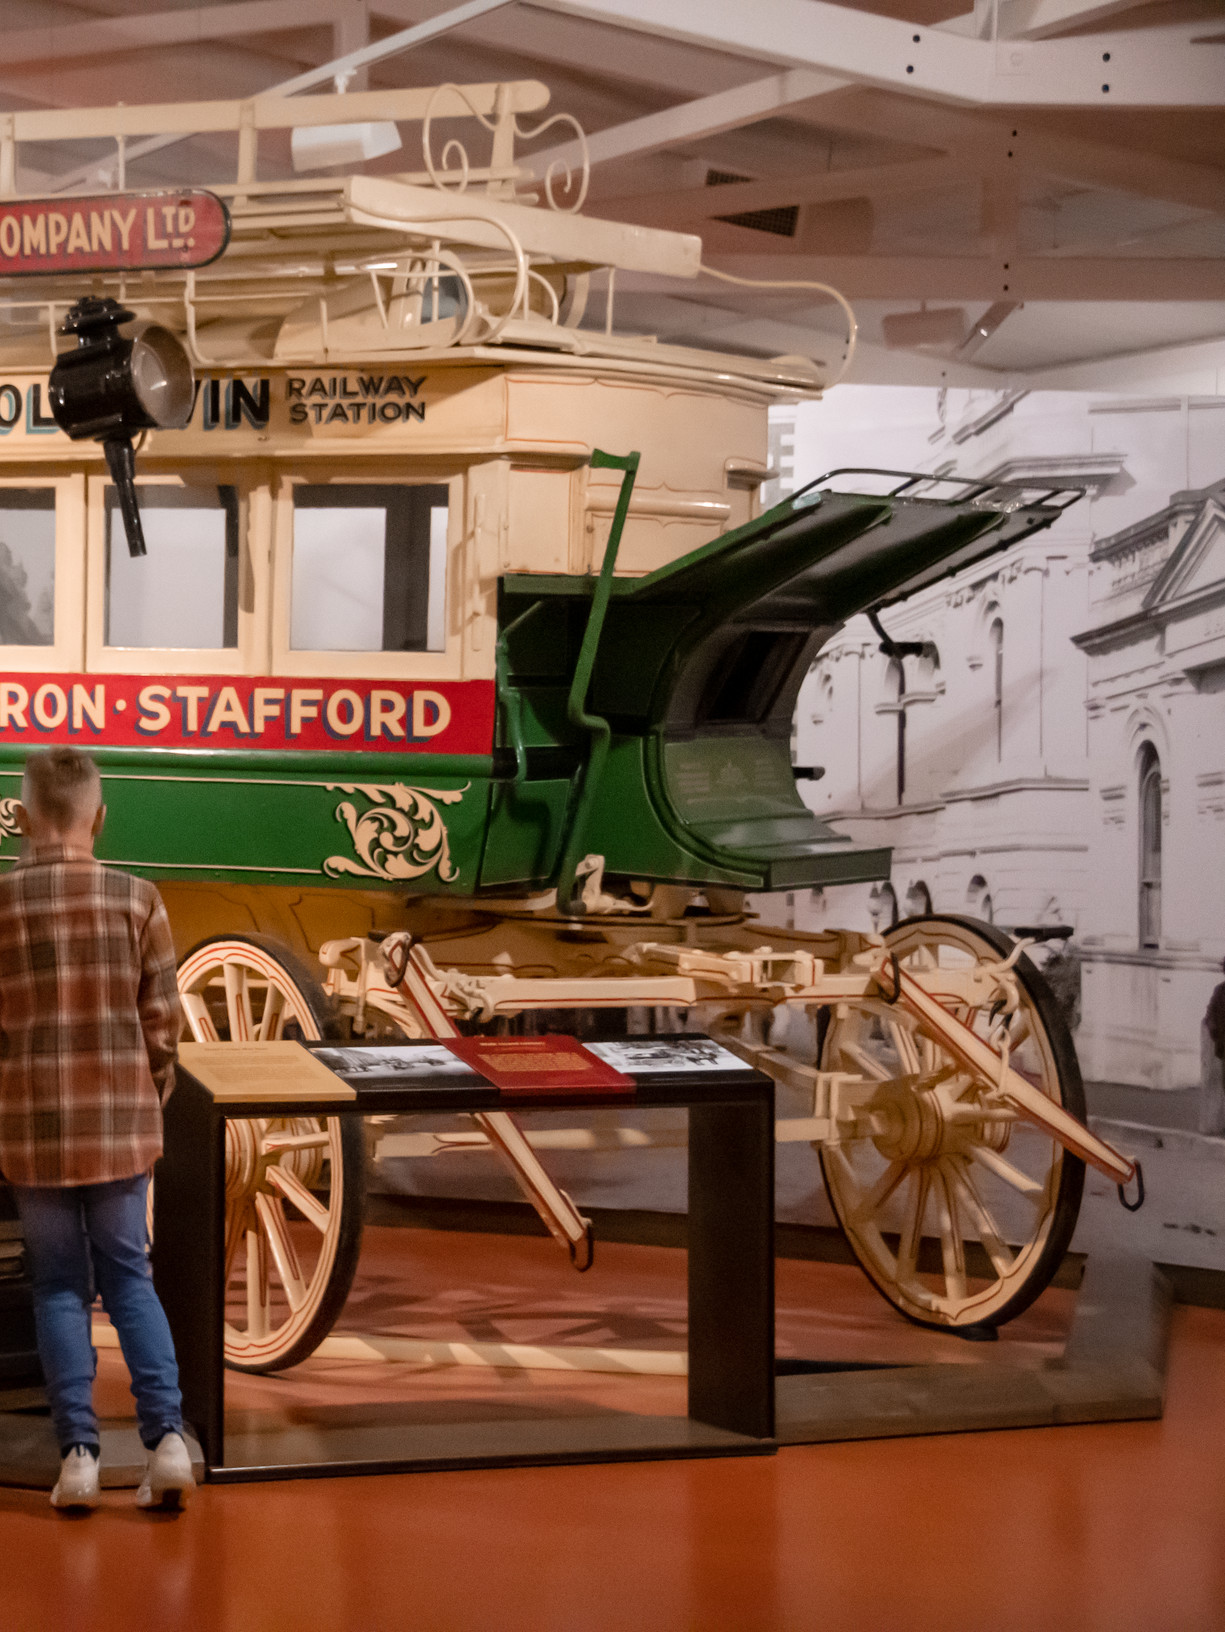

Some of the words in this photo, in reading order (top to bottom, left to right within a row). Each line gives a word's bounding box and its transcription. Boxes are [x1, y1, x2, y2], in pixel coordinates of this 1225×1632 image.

[287, 375, 427, 400] RAILWAY
[289, 402, 426, 425] STATION
[135, 684, 452, 742] STAFFORD
